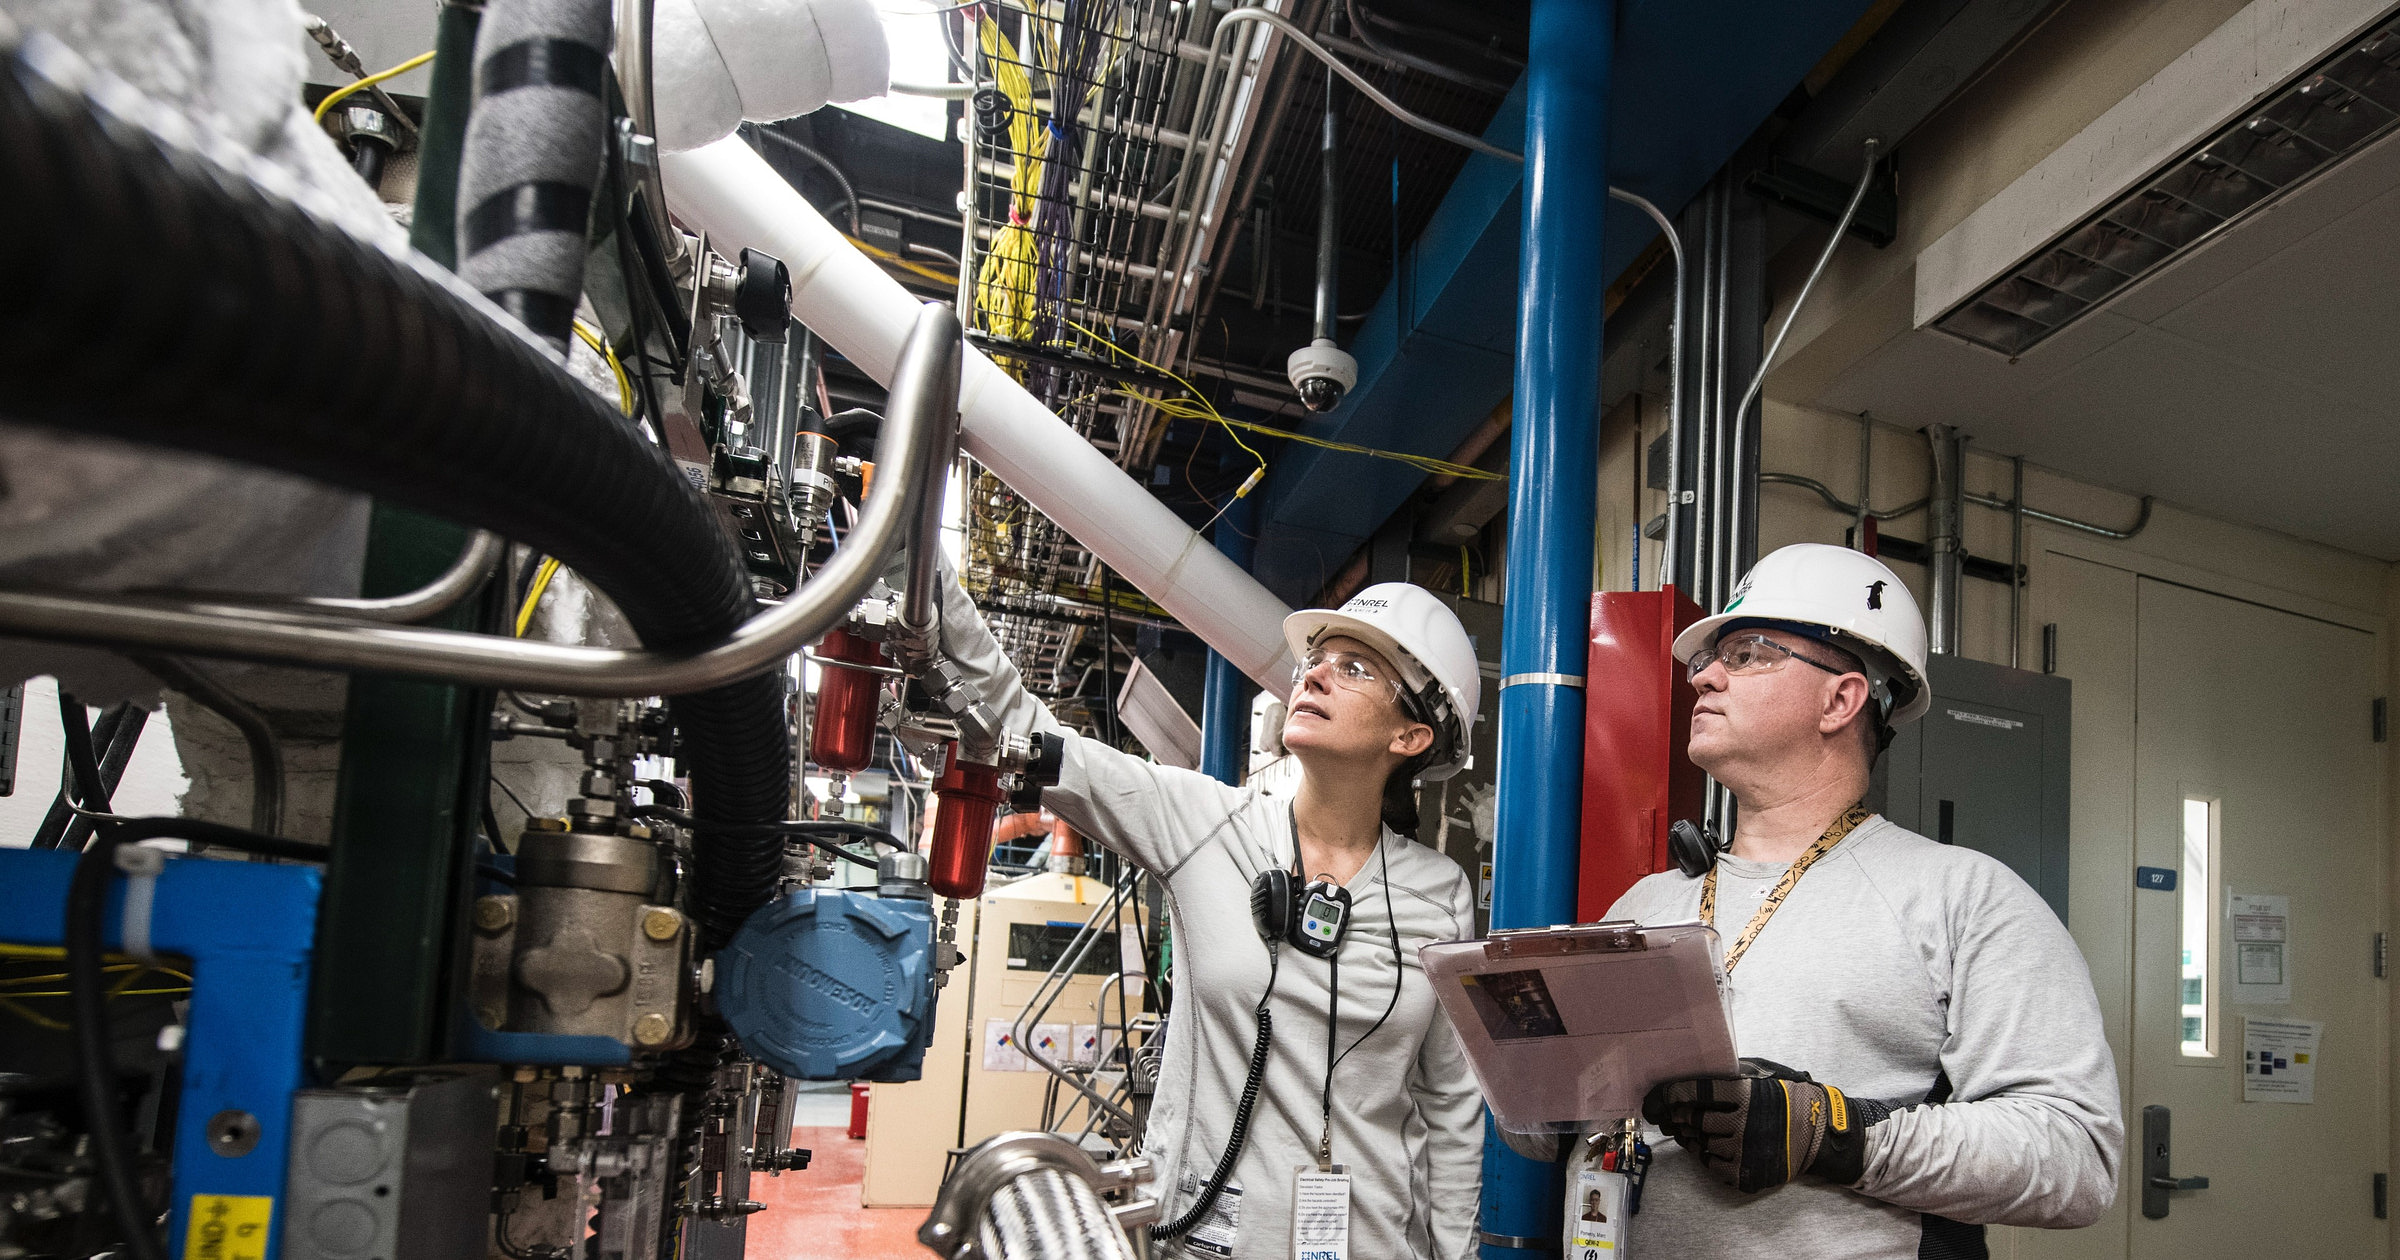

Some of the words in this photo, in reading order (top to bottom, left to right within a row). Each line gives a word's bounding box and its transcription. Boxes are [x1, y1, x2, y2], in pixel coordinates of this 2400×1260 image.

[1357, 599, 1389, 608] NREL
[2151, 873, 2164, 883] 127
[1311, 1252, 1340, 1260] NREL
